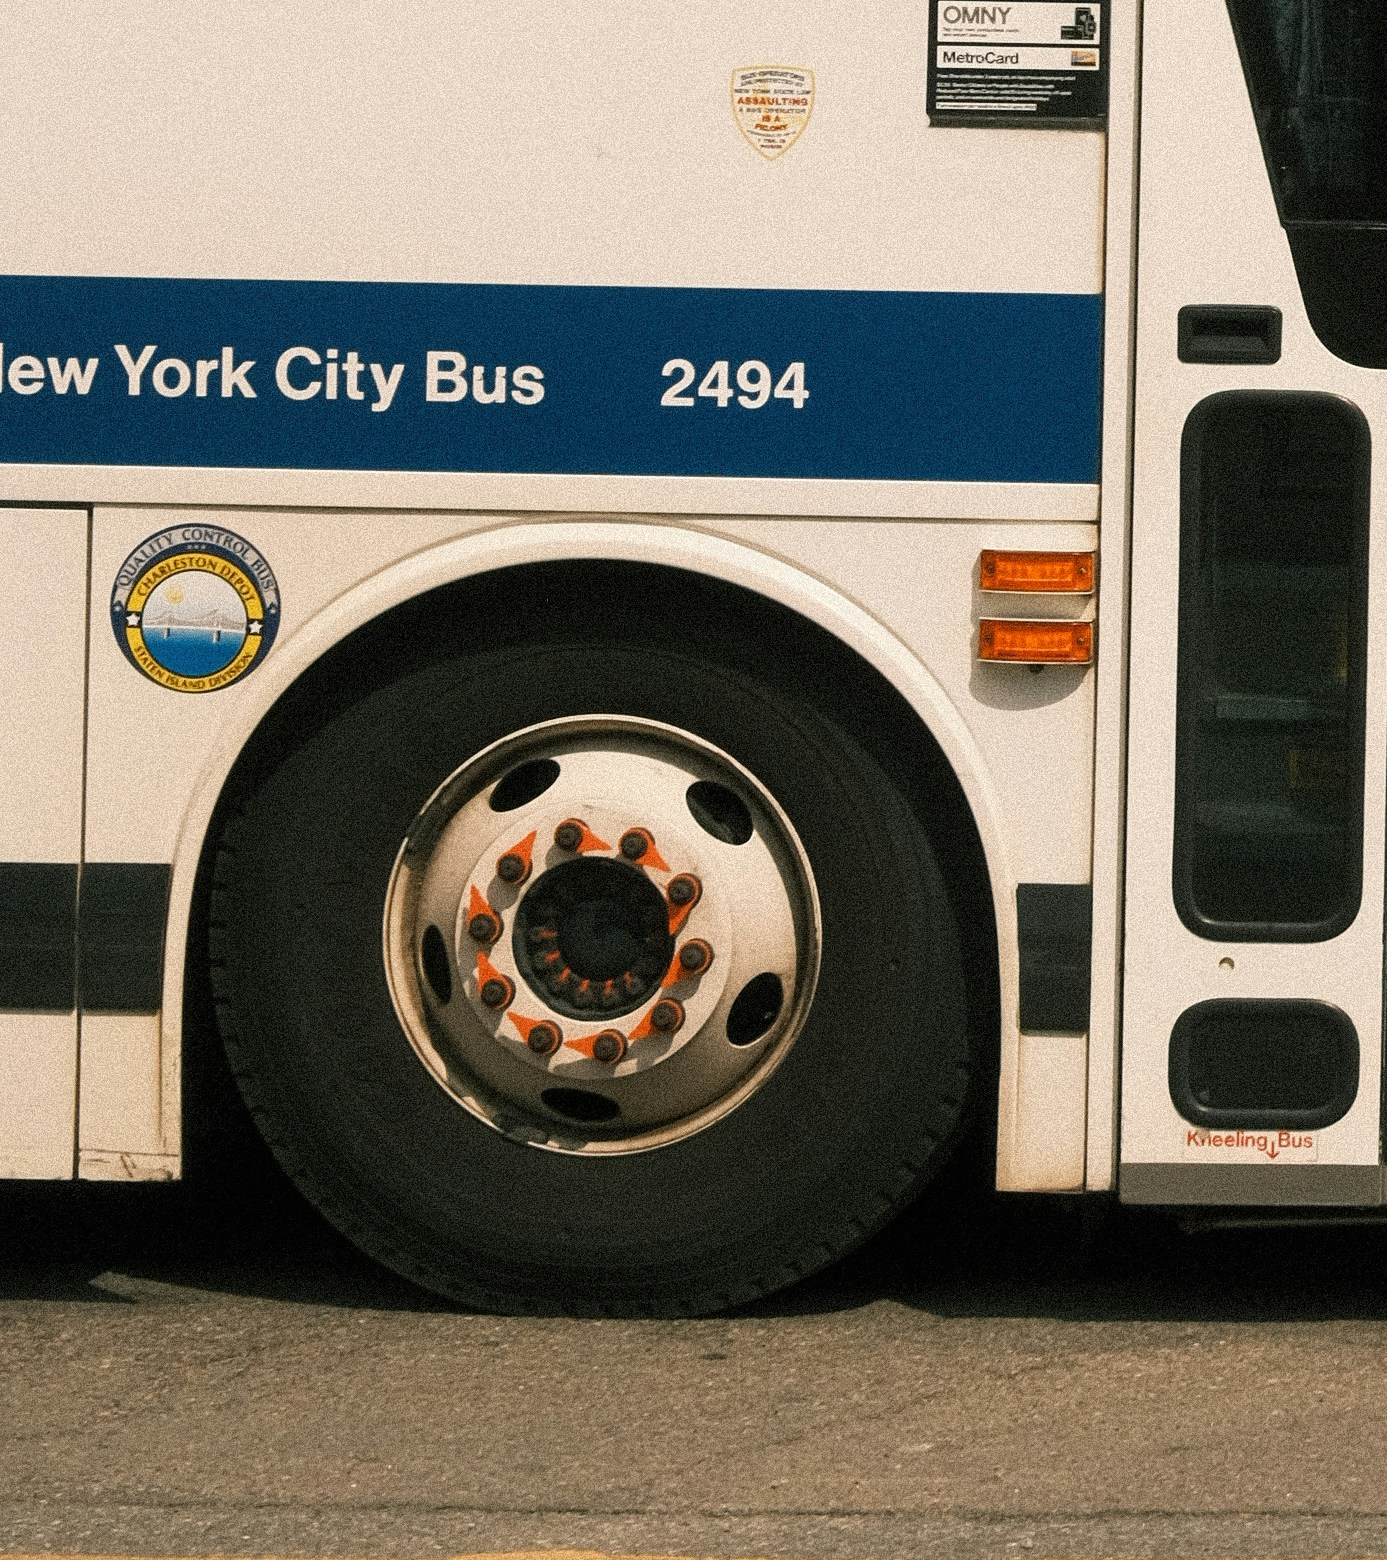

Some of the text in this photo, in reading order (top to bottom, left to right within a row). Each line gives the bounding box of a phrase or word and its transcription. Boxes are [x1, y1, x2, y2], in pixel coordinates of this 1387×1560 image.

[943, 5, 1012, 25] OMNY
[943, 51, 1019, 64] MetroCard
[737, 97, 808, 105] ASSAULTING
[0, 343, 546, 412] ew York City Bus
[660, 358, 810, 409] 2494
[119, 528, 275, 592] QUALITY CONTROL BUS
[137, 556, 257, 602] CHARLESTON DEPOT
[134, 645, 254, 690] STATEN ISLAND DIVISION
[1186, 1130, 1313, 1151] Kneeling Bus
